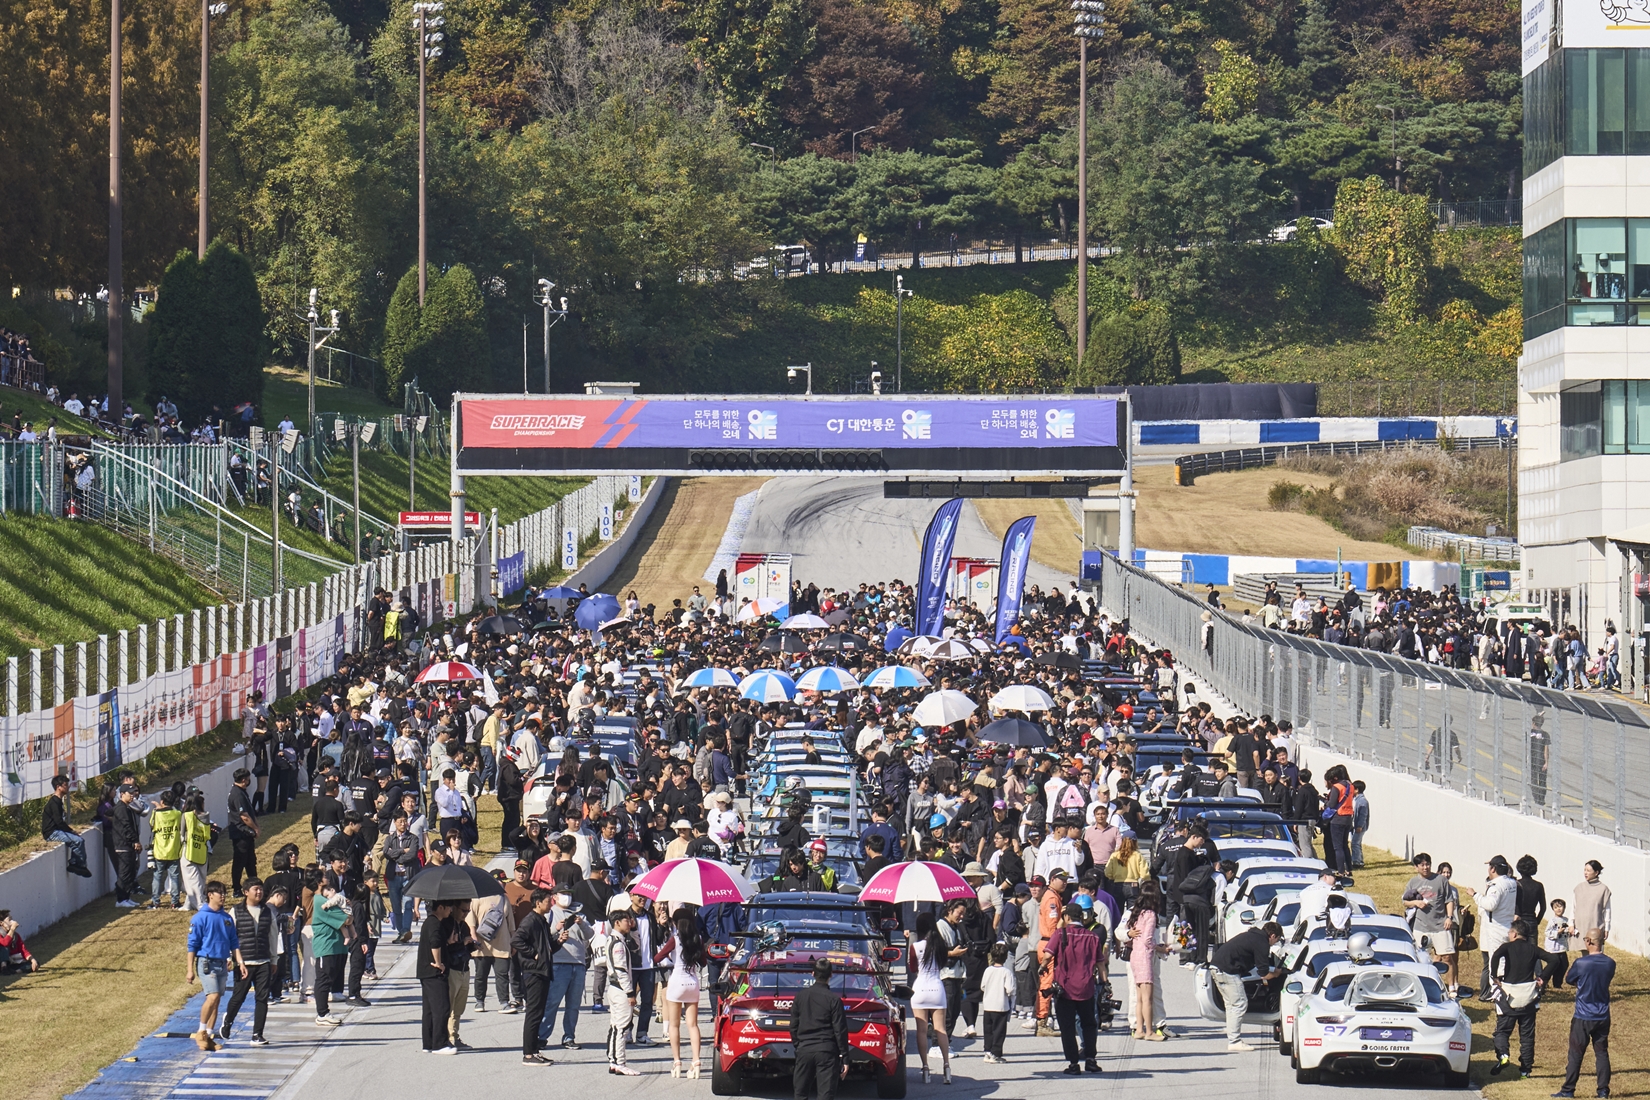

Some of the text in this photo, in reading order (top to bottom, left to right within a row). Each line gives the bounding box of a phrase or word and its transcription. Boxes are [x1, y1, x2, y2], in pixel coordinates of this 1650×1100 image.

[694, 410, 739, 419] 모두를 위한
[992, 409, 1037, 419] 모두를 위한
[490, 414, 586, 430] SUPERRACE
[683, 419, 742, 430] 단 하나의 배송,
[826, 417, 896, 434] CJ 대한통운
[980, 419, 1039, 429] 단 하나의 배송,
[722, 429, 740, 439] 오네
[1020, 429, 1038, 439] 오네
[566, 531, 574, 566] 150
[640, 882, 659, 893] MARY
[869, 887, 893, 895] MARY
[942, 885, 965, 894] MARY
[706, 889, 733, 898] MARY
[804, 941, 820, 949] ZIC
[1324, 1025, 1348, 1037] 97
